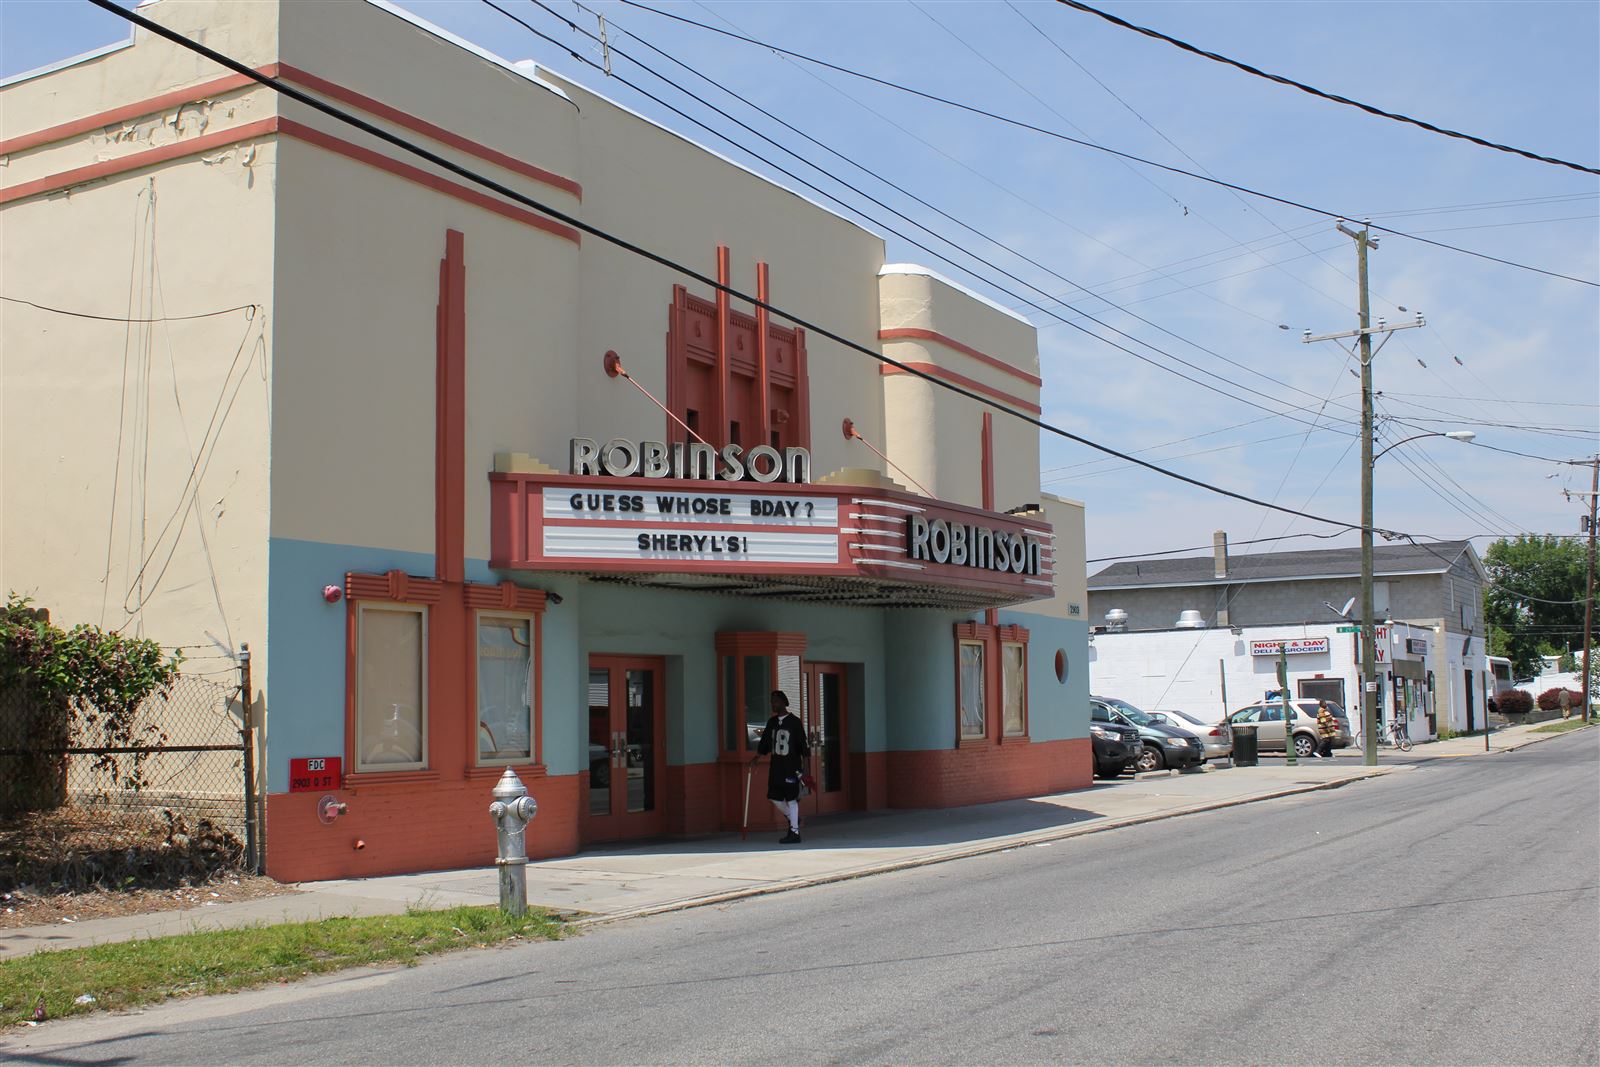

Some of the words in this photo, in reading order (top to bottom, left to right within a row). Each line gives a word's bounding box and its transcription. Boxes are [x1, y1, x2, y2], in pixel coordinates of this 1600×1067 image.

[569, 437, 811, 484] ROBINSON
[570, 493, 644, 512] GUESS
[656, 496, 731, 516] WHOSE
[637, 533, 748, 553] SHERYL'S!
[906, 514, 1042, 576] ROBINSON
[308, 760, 324, 770] FDC
[323, 776, 332, 786] ST
